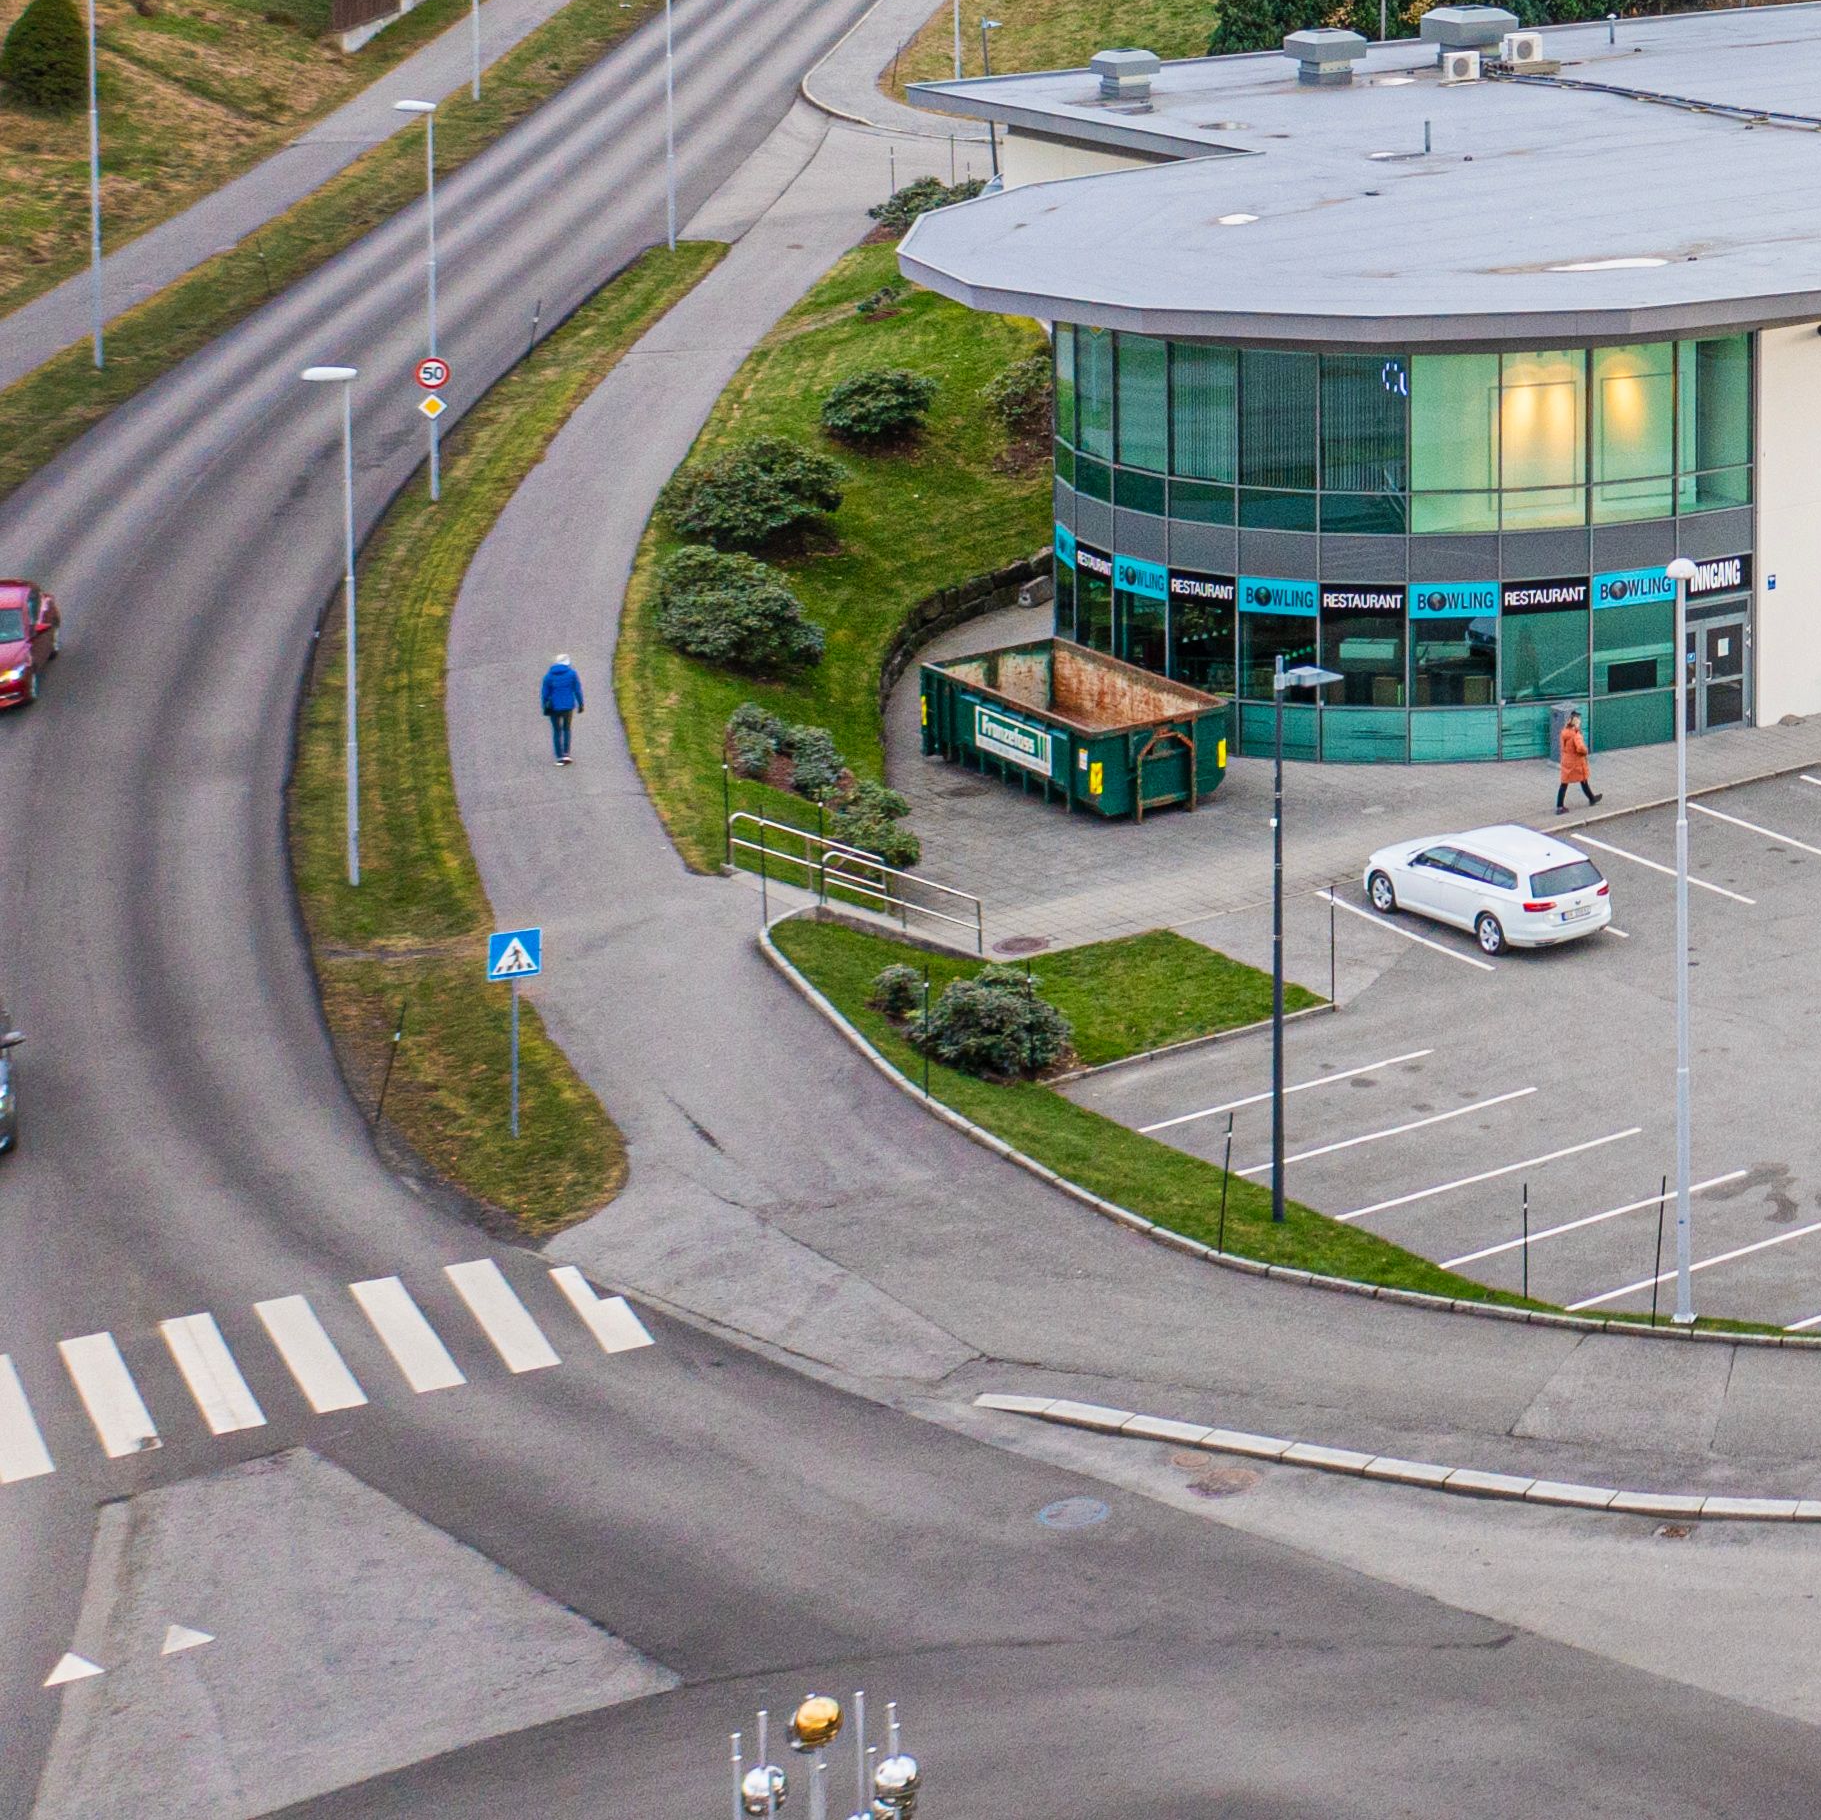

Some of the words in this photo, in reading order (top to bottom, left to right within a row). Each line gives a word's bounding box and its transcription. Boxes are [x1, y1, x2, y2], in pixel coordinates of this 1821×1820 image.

[422, 366, 444, 381] 50
[1690, 558, 1741, 593] INNGANG
[1171, 578, 1235, 601] RESTAURANT
[1246, 586, 1314, 609] BOWLING
[1504, 585, 1587, 607] RESTAURANT
[1601, 575, 1672, 601] BOWLING
[1323, 593, 1403, 610] RESTAURANT
[1417, 590, 1494, 612] BOWLING
